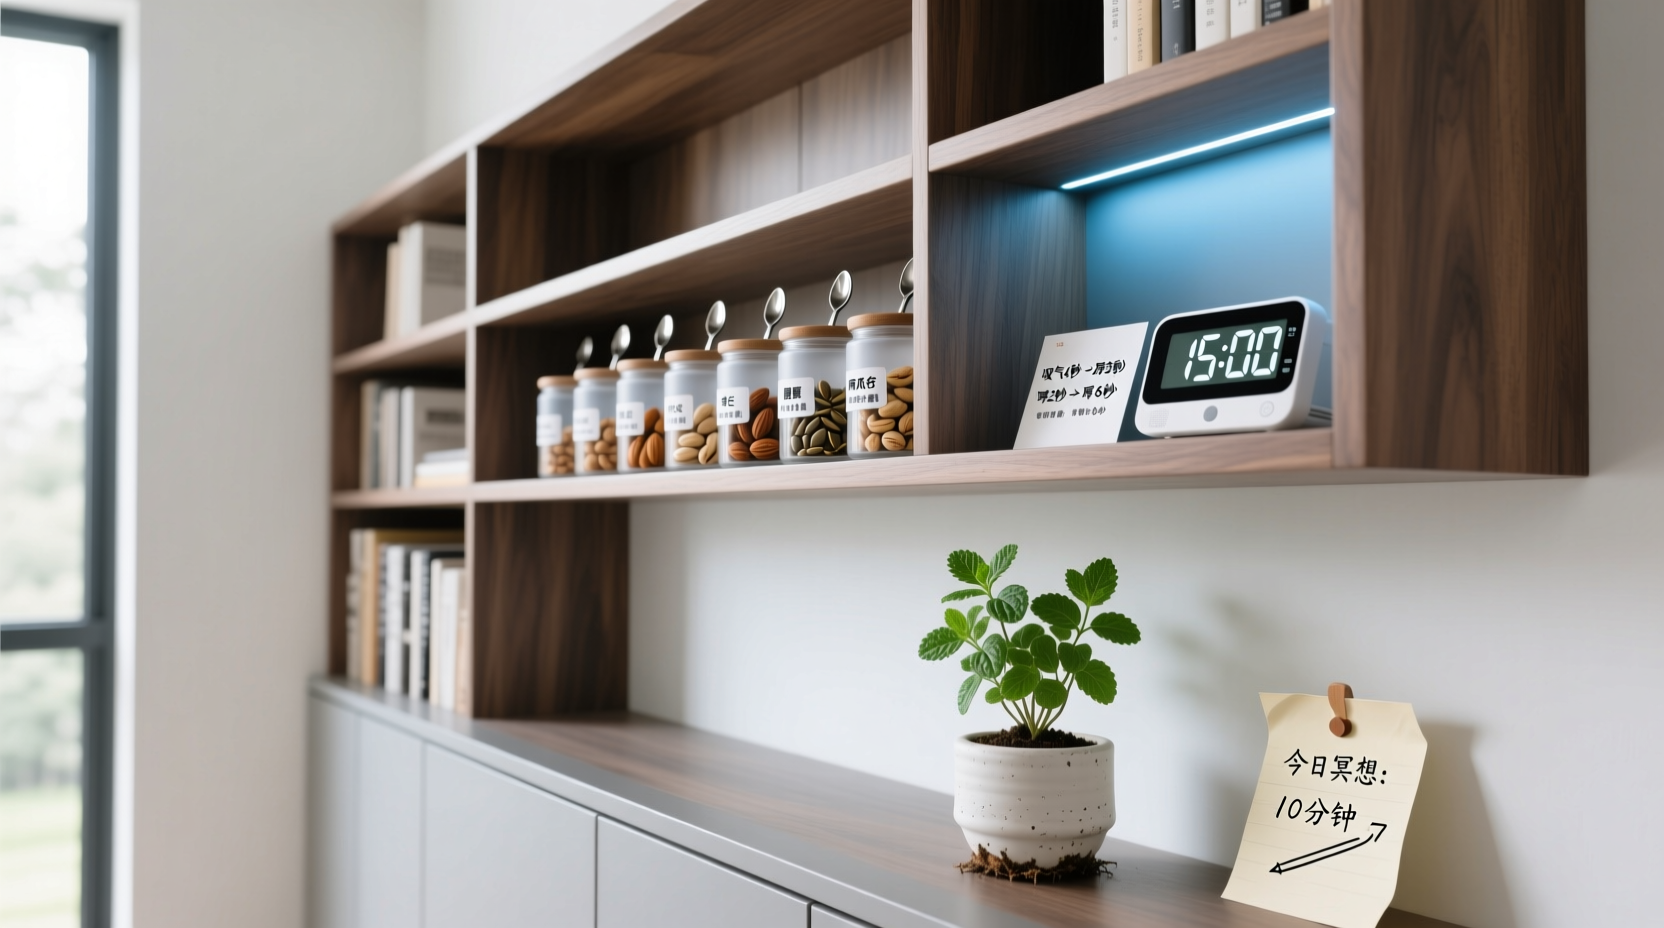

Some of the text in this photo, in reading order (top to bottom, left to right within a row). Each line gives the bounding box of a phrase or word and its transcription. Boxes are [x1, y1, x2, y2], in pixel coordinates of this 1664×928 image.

[1184, 325, 1283, 382] 15:00
[1283, 748, 1387, 786] 今日冥想:
[1275, 795, 1357, 832] 10分钟
